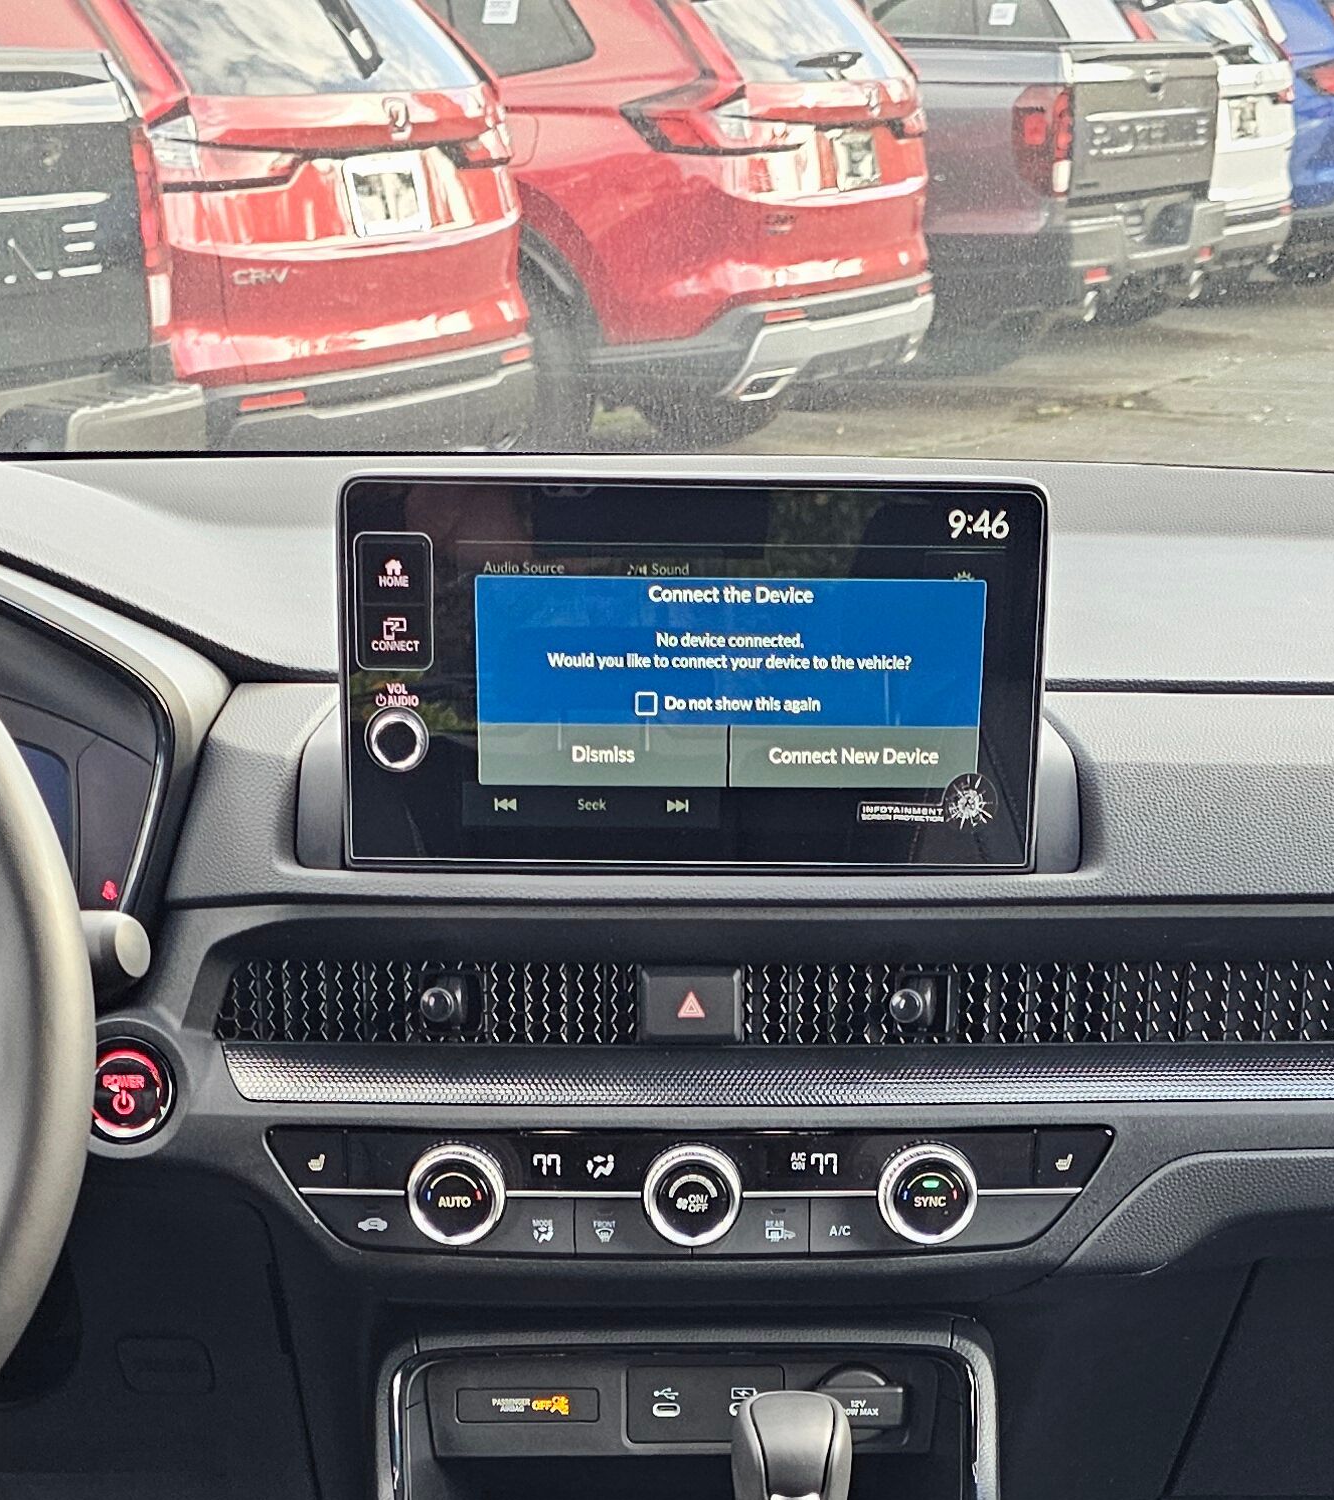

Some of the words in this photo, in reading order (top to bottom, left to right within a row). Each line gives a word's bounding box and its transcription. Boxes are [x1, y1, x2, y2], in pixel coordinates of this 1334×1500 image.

[232, 265, 290, 285] CR-V
[948, 510, 1009, 539] 9:46
[483, 561, 519, 574] Audio
[522, 562, 565, 575] Source
[652, 563, 689, 576] Sound
[378, 575, 409, 587] HOME
[648, 585, 719, 603] Connect
[724, 586, 751, 603] the
[755, 586, 815, 604] Device
[371, 640, 420, 651] CONNECT
[656, 632, 678, 648] No
[680, 632, 725, 648] device
[728, 633, 804, 649] connected.
[547, 652, 594, 668] Would
[596, 656, 624, 670] you
[626, 652, 651, 668] like
[653, 654, 669, 668] to
[672, 655, 727, 669] connect
[730, 656, 763, 671] your
[766, 654, 810, 670] device
[812, 656, 829, 670] to
[831, 655, 855, 670] the
[857, 655, 912, 671] vehicle?
[386, 683, 408, 694] VOL
[387, 695, 419, 706] AUDIO
[664, 695, 687, 711] Do
[689, 697, 712, 711] not
[715, 696, 753, 711] show
[755, 697, 782, 711] this
[783, 697, 821, 713] again
[571, 744, 635, 764] Dismiss
[768, 747, 838, 765] Connect
[841, 748, 879, 765] New
[883, 748, 939, 765] Device
[577, 798, 607, 812] Seek
[862, 805, 944, 816] INFOTAINMENT
[102, 1074, 145, 1089] POWER
[791, 1152, 806, 1162] A/C
[792, 1161, 806, 1171] ON
[438, 1196, 471, 1208] AUTO
[687, 1194, 708, 1204] ON/
[913, 1196, 947, 1208] SYNC
[687, 1203, 709, 1213] OFF
[593, 1220, 616, 1229] FRONT
[829, 1225, 851, 1237] A/C
[531, 1400, 552, 1411] OFF
[850, 1400, 867, 1408] 12V
[859, 1408, 879, 1416] MAX
